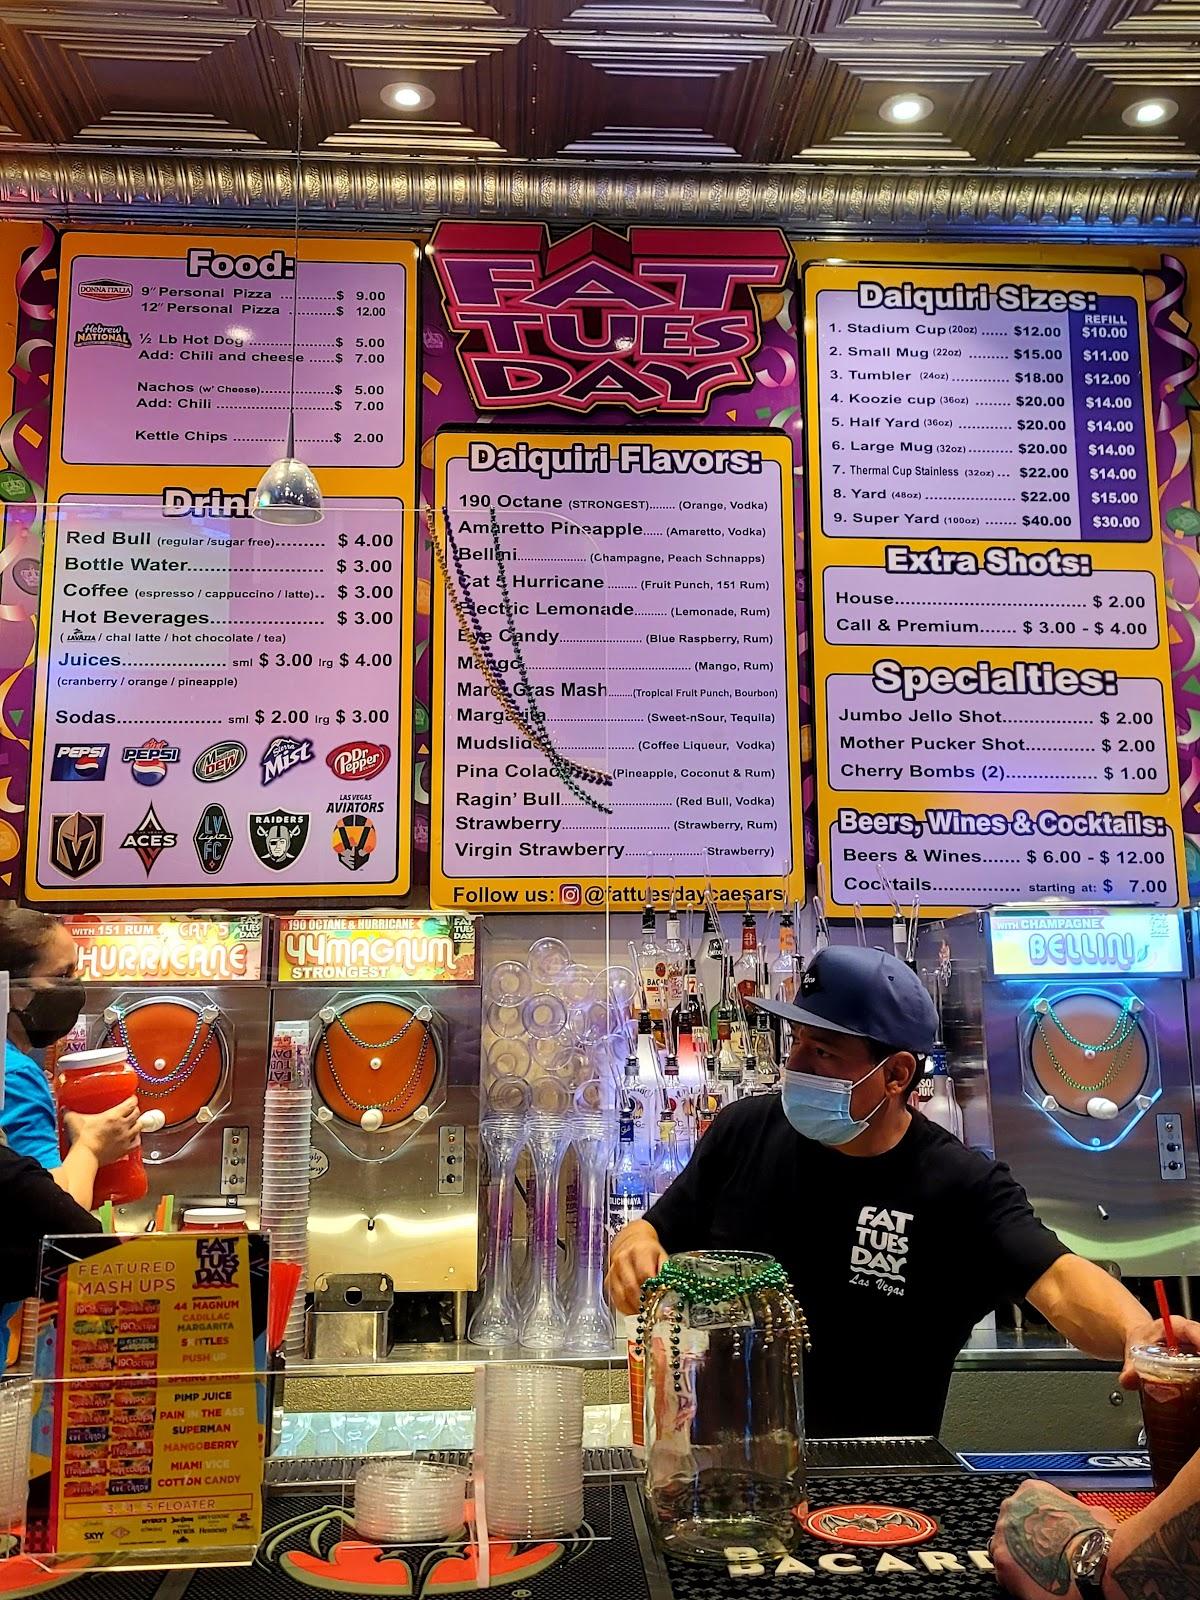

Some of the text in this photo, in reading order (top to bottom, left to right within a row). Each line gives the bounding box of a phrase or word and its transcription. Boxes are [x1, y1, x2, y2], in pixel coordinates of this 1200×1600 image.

[188, 250, 295, 278] Food:
[442, 259, 778, 310] FAT
[159, 287, 385, 301] Personal Pizza 9.00
[859, 283, 1097, 314] Daiquiri Sizes:
[167, 303, 386, 317] Personal Pizza 12.00
[1085, 314, 1127, 325] REFILL
[85, 324, 122, 334] Hebrew
[457, 312, 749, 356] TUES
[847, 324, 1128, 338] Stadium Cup $12.00 $10.00
[78, 333, 129, 343] NATIONAL
[183, 334, 385, 348] Hot Dog 5.00
[138, 350, 304, 363] Add: Chili and cheese
[471, 358, 738, 403] DAY
[849, 370, 1064, 384] Tumbler $18.00
[138, 382, 194, 393] Nachos
[849, 394, 936, 407] Koozie cup
[850, 418, 920, 428] Half Yard
[135, 430, 383, 443] Kettle Chips 2.00
[469, 443, 762, 478] Daiquiri Flavors:
[850, 466, 959, 476] Thermal Stainless
[459, 495, 563, 508] 190 Octane
[853, 513, 1140, 528] Super $40.00 $30.00
[666, 527, 766, 537] (Amaretto, Vodka)
[66, 532, 203, 548] Red Bull (regular
[65, 558, 124, 572] Bottle
[668, 553, 765, 564] Peach Schnapps)
[886, 546, 1092, 576] Extra Shots:
[513, 576, 770, 591] Hurricane Punch, 151 Rum)
[63, 584, 274, 601] Coffee (espresso cappuccino
[62, 610, 394, 627] Hot Beverages 3.00
[171, 633, 286, 644] hot chocolate tea)
[275, 654, 333, 668] 3.00 lrg
[57, 677, 238, 688] (cranberry orange pineapple)
[874, 661, 1117, 699] Specialties:
[271, 710, 389, 724] 2.00 3.00
[839, 709, 952, 723] Jumbo Jello
[273, 744, 295, 756] Sierra
[638, 741, 730, 751] (Coffee Liqueur,
[841, 737, 976, 750] Mother Pucker
[57, 747, 106, 758] PEPSI
[124, 749, 179, 761] PEPSI
[352, 749, 369, 759] Dr
[264, 743, 312, 784] Mist
[340, 752, 379, 775] Pepper
[457, 765, 499, 778] Pina
[681, 768, 729, 778] Coconut
[523, 792, 560, 806] Bull
[326, 803, 385, 813] AVIATORS
[205, 816, 223, 833] LV
[839, 810, 1167, 838] Beers, Wines Cocktails:
[124, 835, 175, 847] ACES
[204, 843, 222, 860] FC
[455, 843, 513, 859] Virgin
[453, 887, 521, 903] Follow
[525, 888, 555, 902] us:
[72, 925, 153, 936] WITH 151 RUM
[178, 922, 209, 938] CAT
[288, 918, 415, 931] 190 OCTANE HURRICANE
[997, 919, 1100, 930] WITH CHAMPAGNE
[1029, 933, 1135, 970] BELLINI
[77, 943, 247, 977] HURRICANE
[292, 966, 387, 979] STRONGEST
[858, 1206, 914, 1234] FAT
[196, 1238, 239, 1257] FAT
[856, 1226, 909, 1255] TUES
[200, 1255, 239, 1269] TUES
[851, 1246, 907, 1274] DAY
[79, 1261, 176, 1276] FEATURED
[195, 1270, 237, 1284] DAY
[78, 1279, 176, 1295] MASH UPS
[849, 1274, 905, 1296] Las Vegas
[174, 1301, 239, 1311] 44 MAGNUM
[183, 1313, 230, 1322] CADILLAC
[177, 1323, 234, 1332] MARGARITA
[175, 1392, 232, 1402] PIMP JUICE
[160, 1409, 221, 1420] PAIN THE
[173, 1424, 231, 1435] SUPERMAN
[171, 1461, 202, 1471] MIAMI
[158, 1475, 241, 1487] COTTON CANDY
[159, 1500, 215, 1511] FLOATER
[84, 1532, 104, 1541] SKYY
